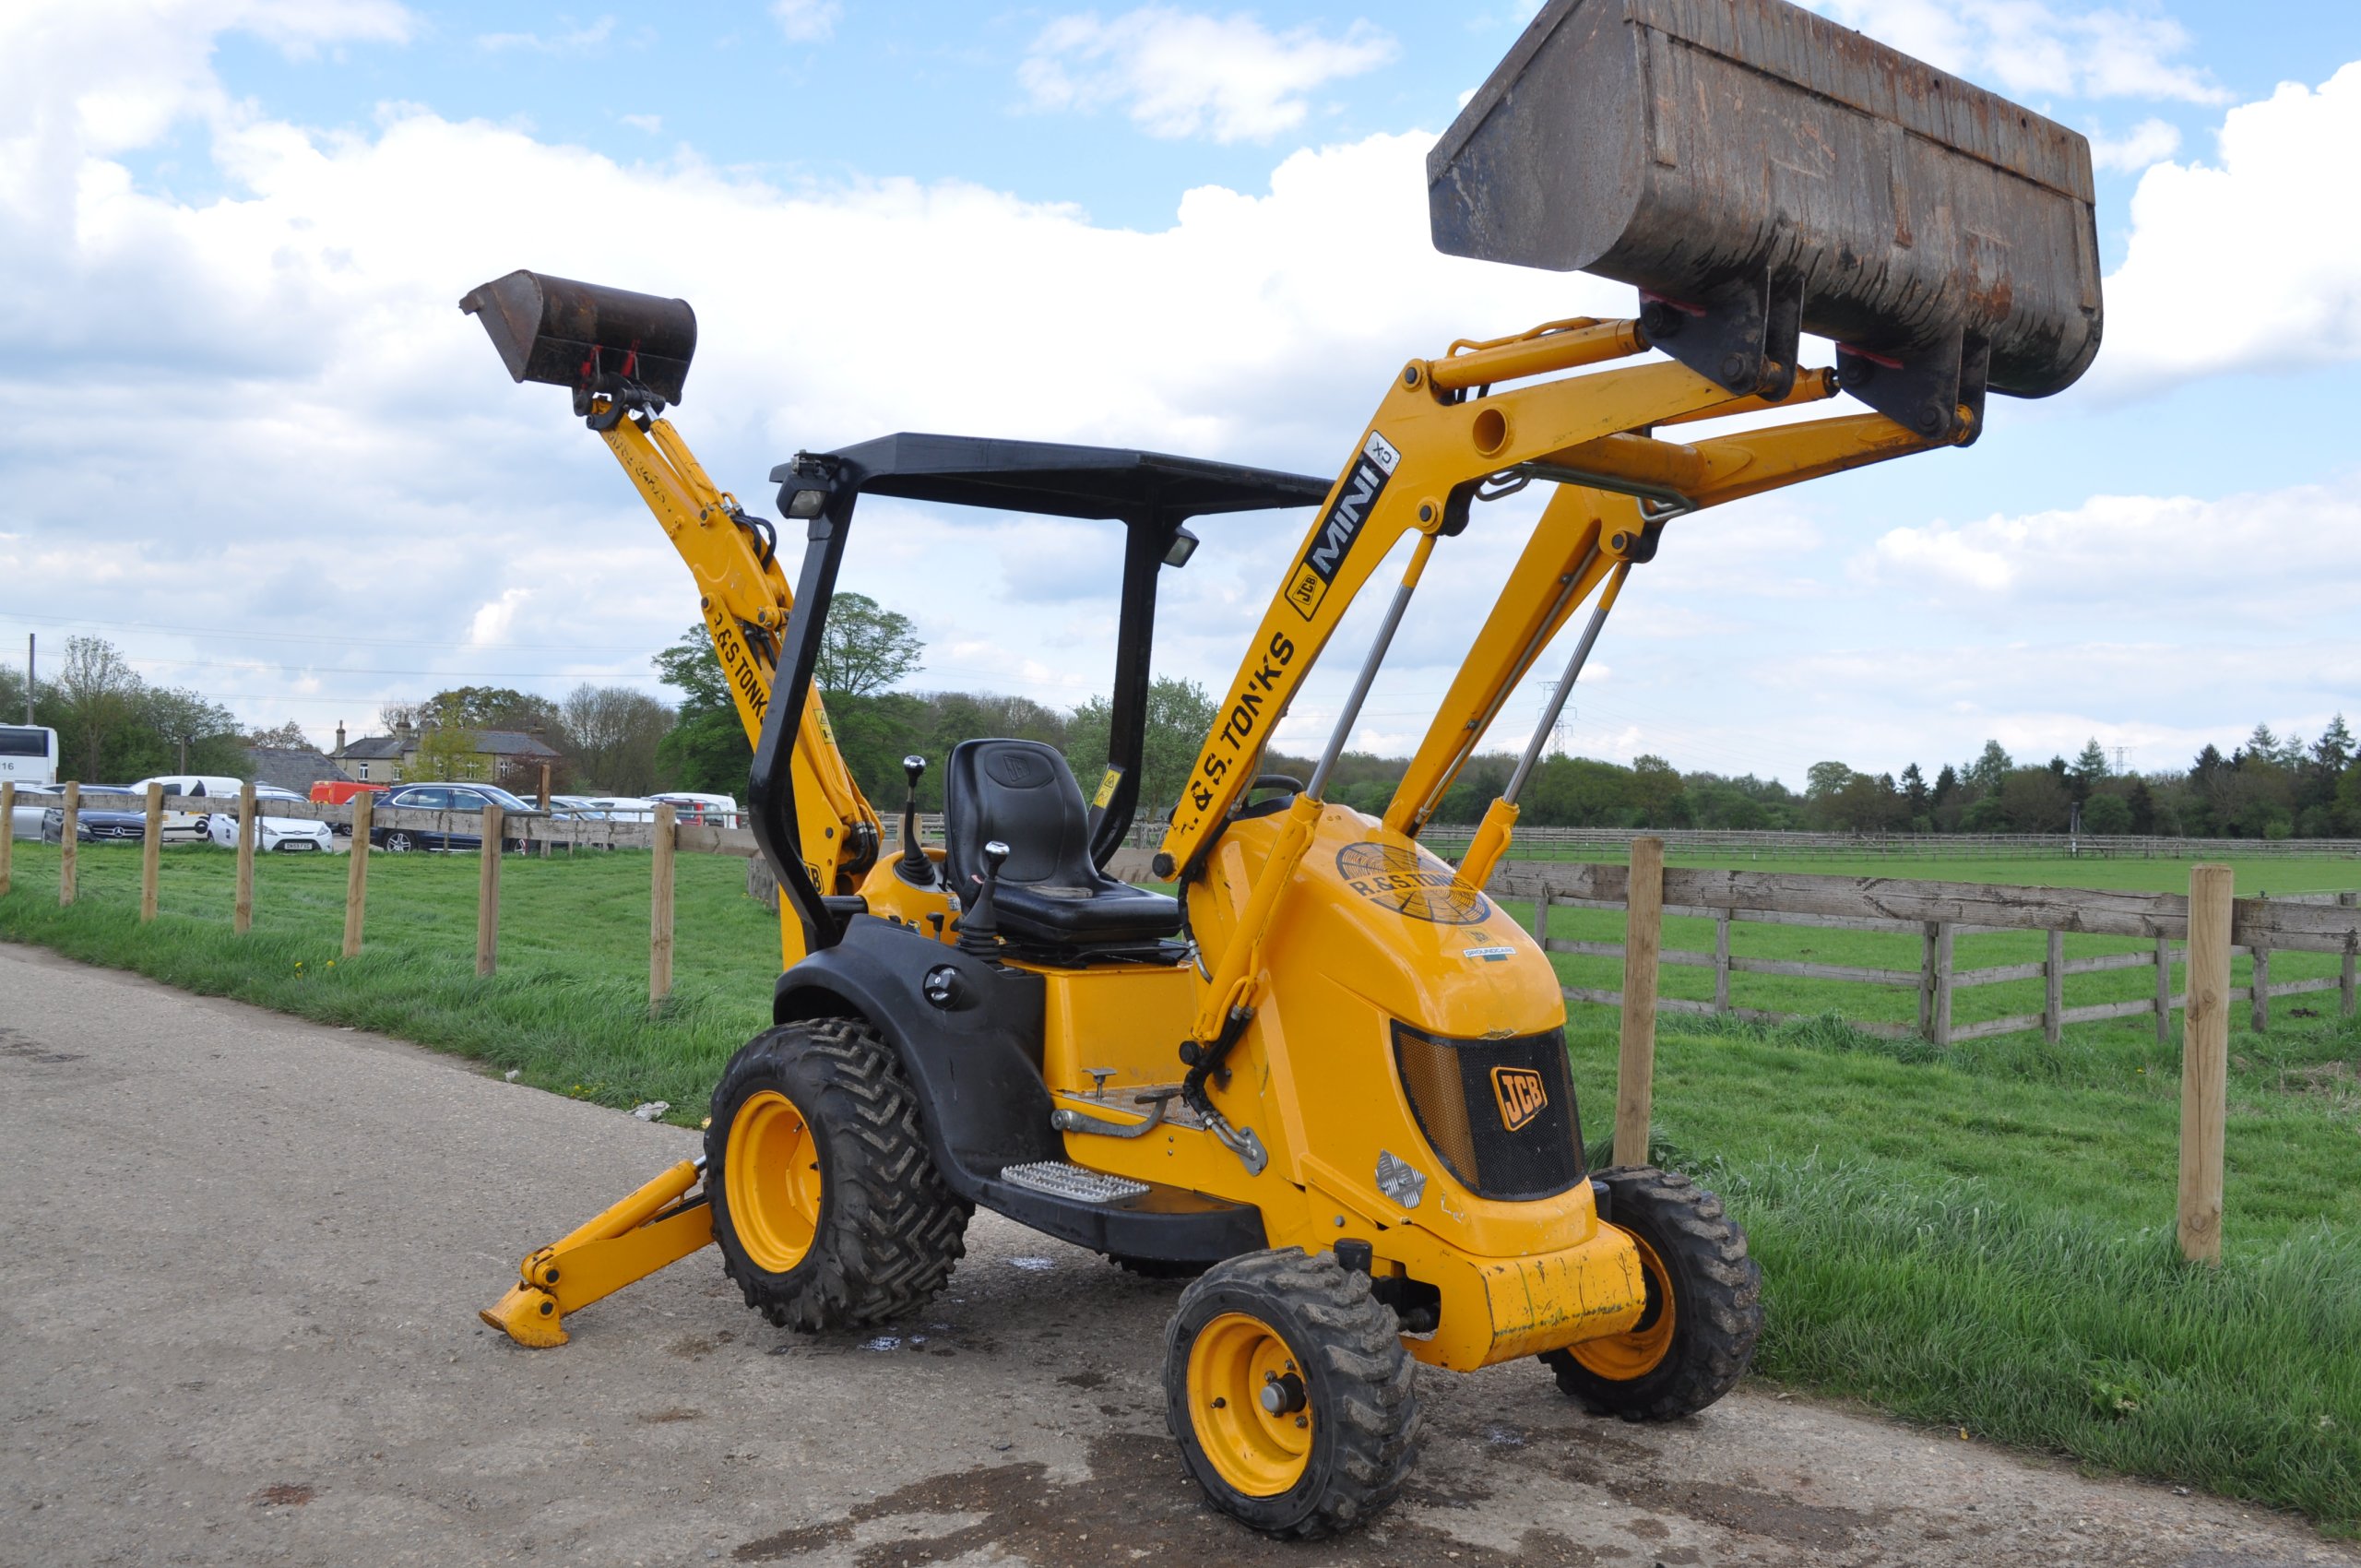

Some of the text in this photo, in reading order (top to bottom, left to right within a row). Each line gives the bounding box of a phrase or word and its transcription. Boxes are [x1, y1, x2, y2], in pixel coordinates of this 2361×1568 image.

[1312, 464, 1380, 575] MINI
[1297, 576, 1316, 602] JCB
[1501, 1075, 1543, 1123] JCB
